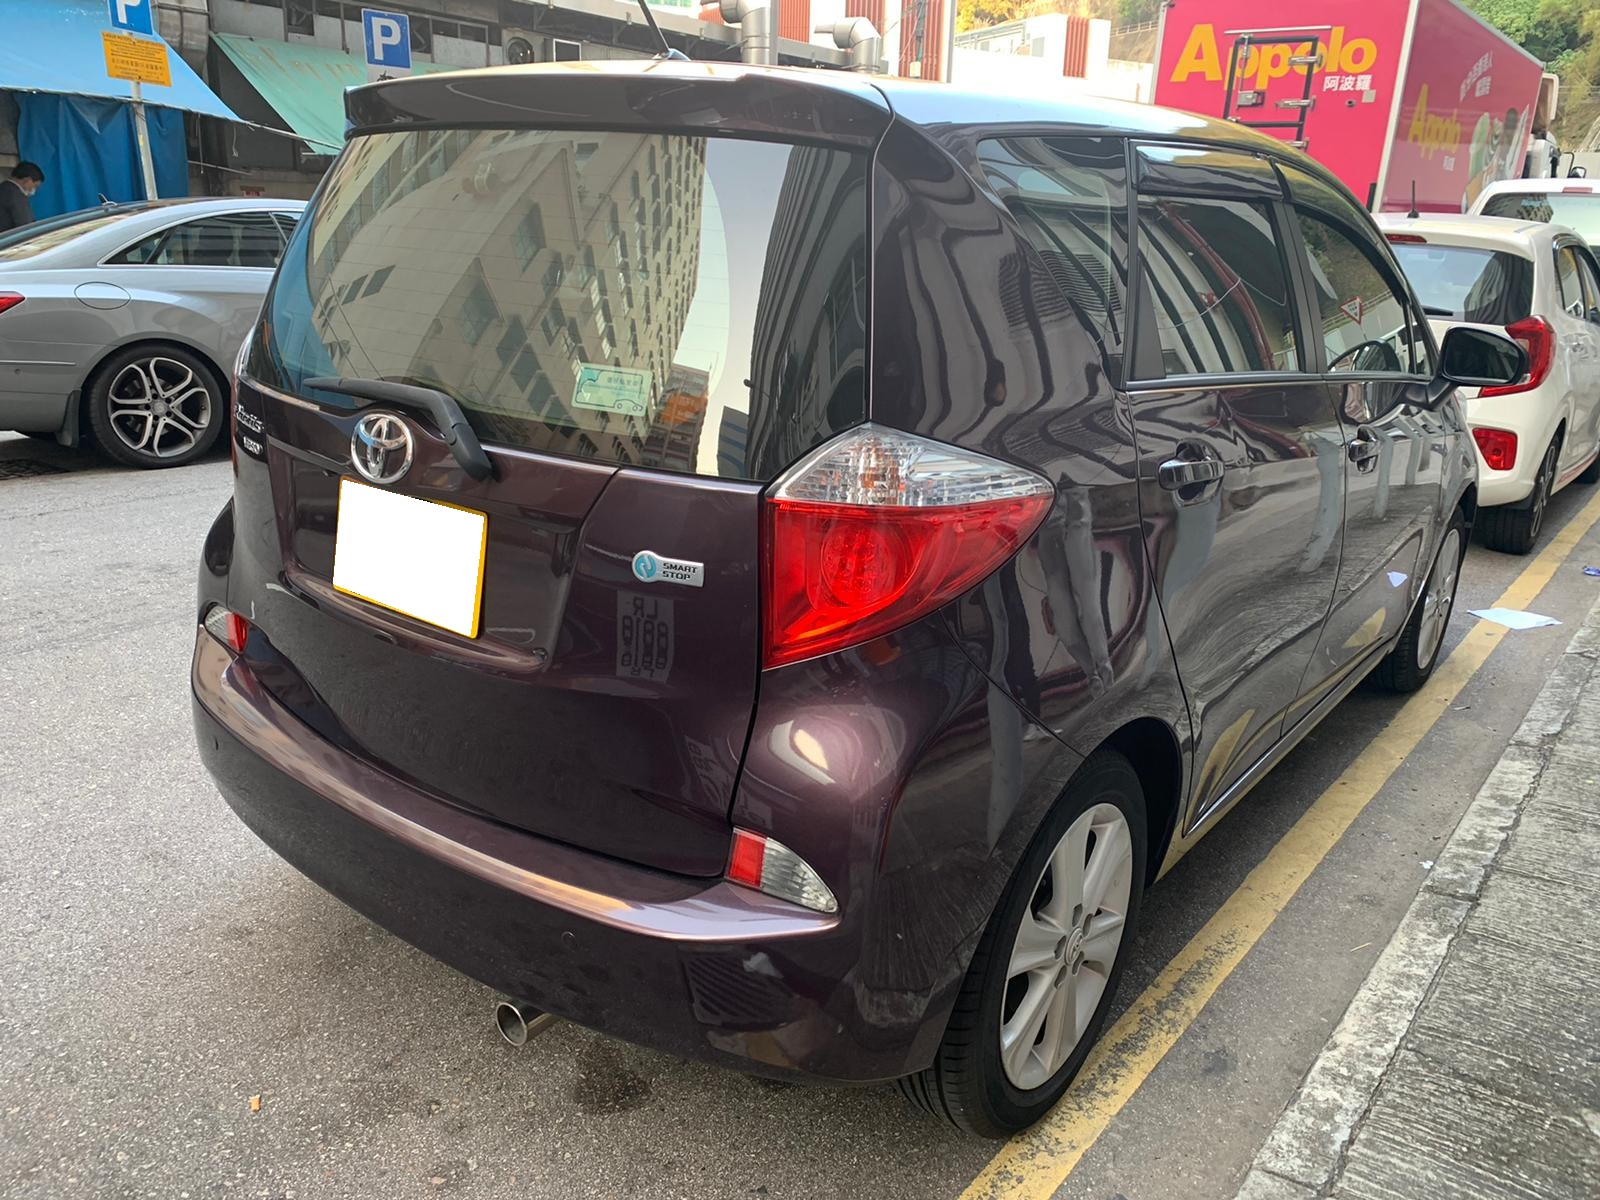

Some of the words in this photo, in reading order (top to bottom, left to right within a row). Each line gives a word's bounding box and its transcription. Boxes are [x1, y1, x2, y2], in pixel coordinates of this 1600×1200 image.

[371, 16, 401, 61] P
[1169, 23, 1378, 91] Appolo
[1322, 74, 1373, 92] 阿波羅
[1408, 82, 1461, 161] Appolo
[662, 570, 691, 580] STOP
[663, 562, 698, 574] SMART
